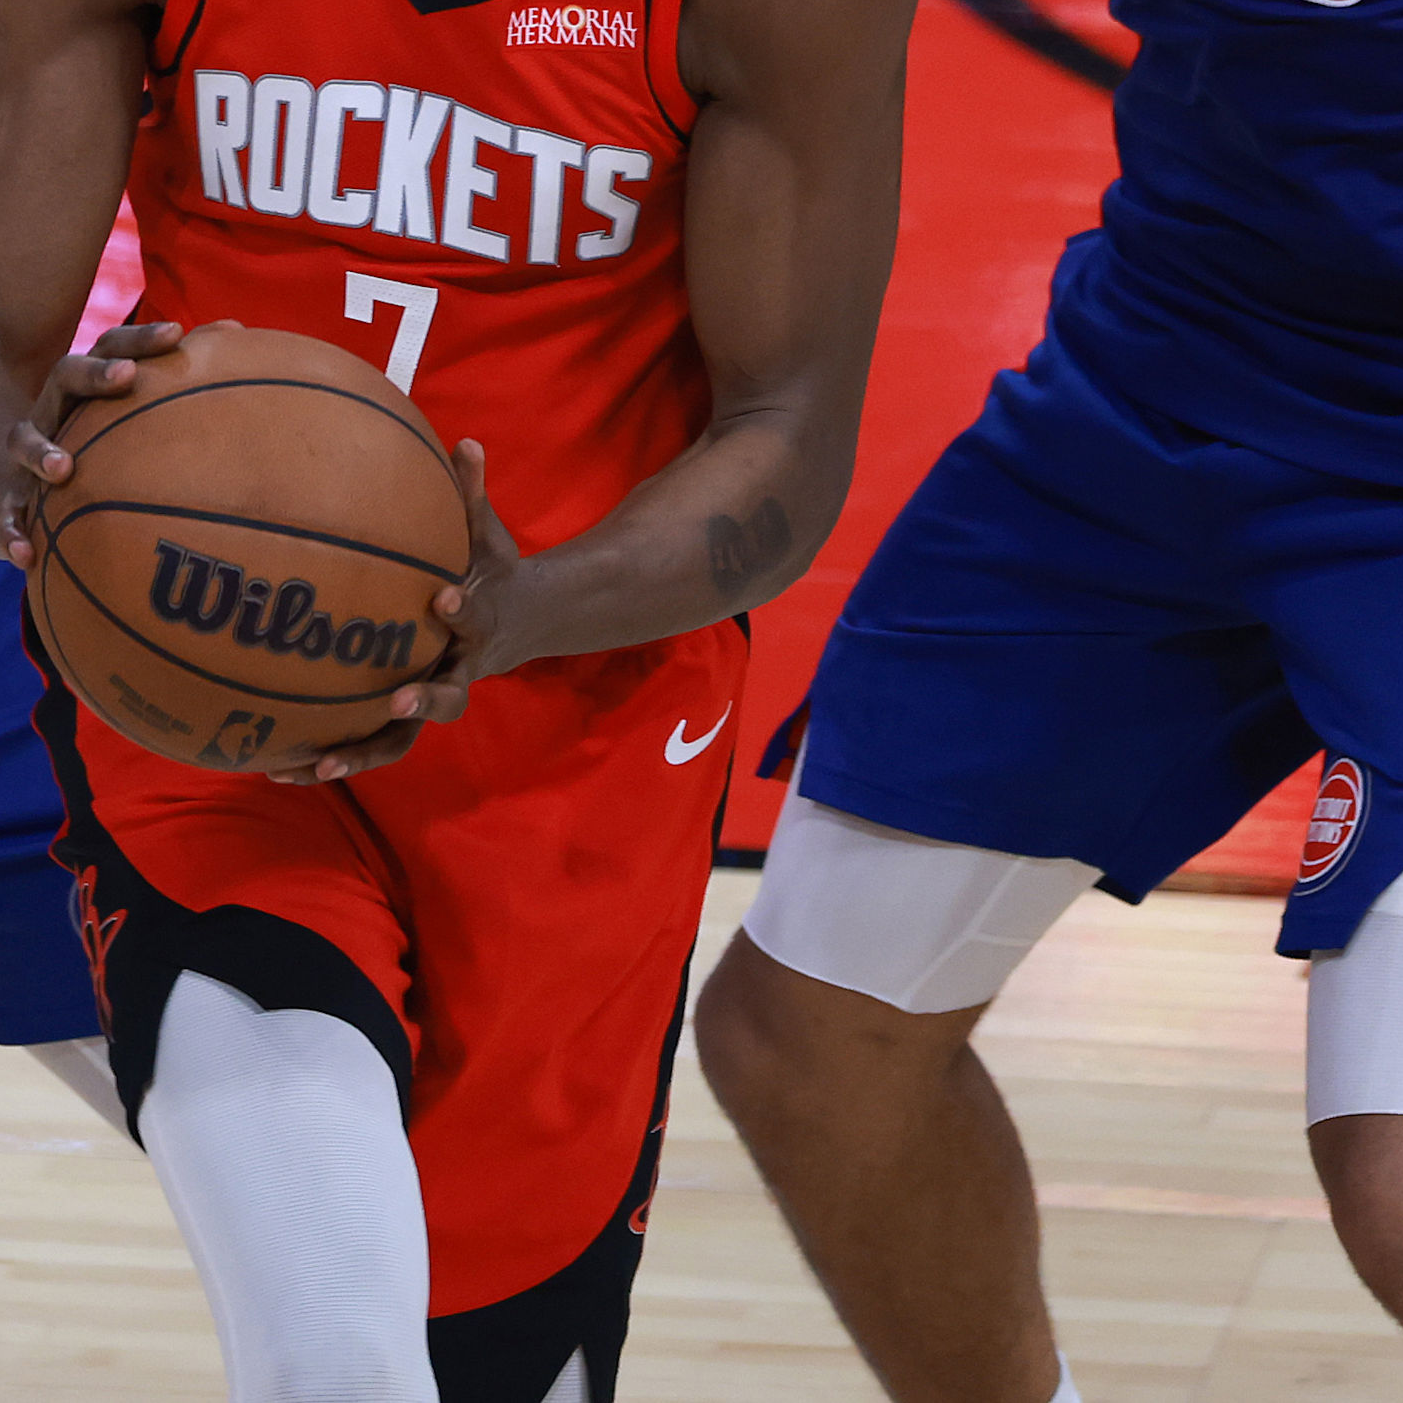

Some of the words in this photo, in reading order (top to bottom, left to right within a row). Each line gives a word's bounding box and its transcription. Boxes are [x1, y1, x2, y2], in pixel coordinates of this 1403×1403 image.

[505, 24, 637, 49] HERMANN
[508, 4, 638, 32] MEMORIAL
[194, 69, 654, 266] ROCKETS
[343, 270, 439, 397] 7
[151, 538, 418, 669] Wilson
